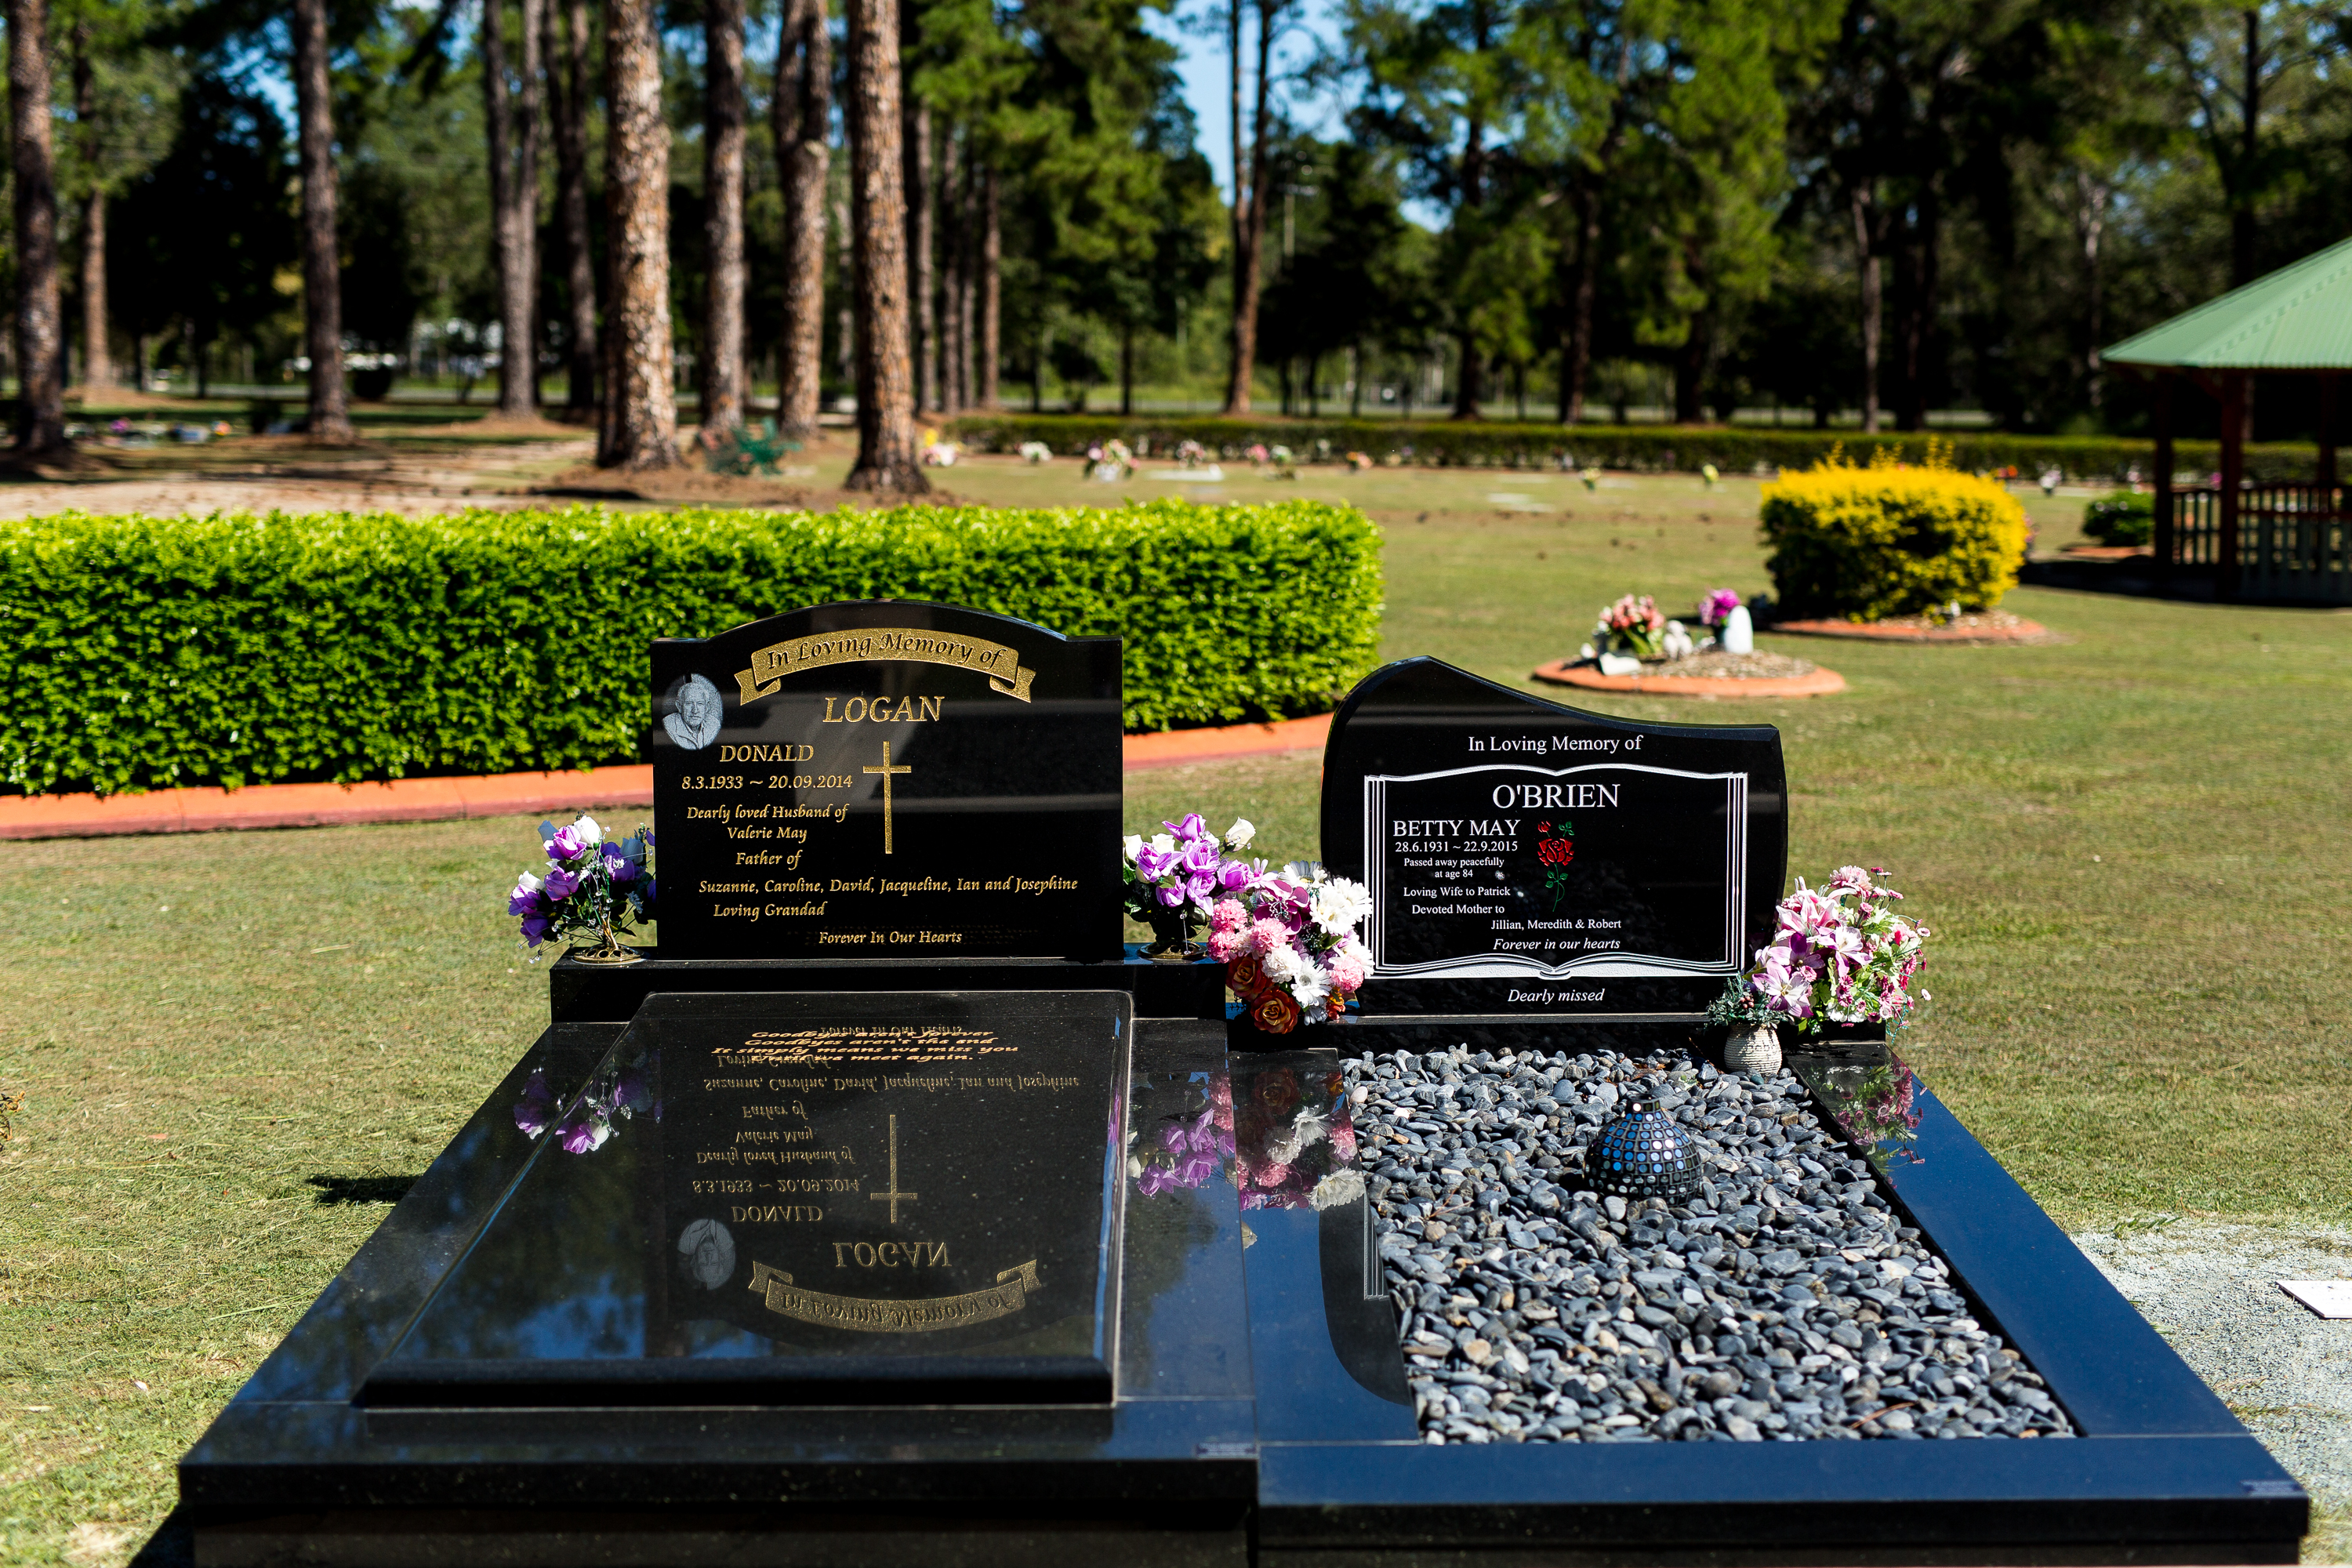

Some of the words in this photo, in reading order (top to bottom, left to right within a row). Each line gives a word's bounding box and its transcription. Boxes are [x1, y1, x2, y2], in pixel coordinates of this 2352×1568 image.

[768, 651, 791, 670] In
[798, 636, 871, 660] Loving
[879, 632, 972, 661] Memory
[979, 648, 1003, 669] of
[822, 695, 946, 723] LOGAN
[719, 744, 815, 762] DONALD
[1468, 736, 1485, 751] In
[1490, 735, 1547, 755] Loving
[1552, 735, 1621, 754] Memory
[1624, 734, 1644, 750] of
[681, 775, 743, 789] 8.3.1933
[768, 775, 853, 789] 20.09.2014
[1492, 783, 1621, 809] O'BRIEN
[687, 804, 731, 824] Dearly
[735, 804, 771, 818] loved
[771, 803, 833, 818] Husband
[833, 803, 851, 823] of
[727, 825, 773, 839] Valerie
[776, 826, 808, 844] May
[1392, 819, 1465, 837] BETTY
[1469, 819, 1521, 836] MAY
[1395, 841, 1449, 852] 28.6.1931
[1463, 840, 1518, 852] 22.9.2015
[735, 849, 783, 865] Father
[786, 849, 804, 871] of
[1403, 857, 1433, 866] Passed
[1435, 859, 1457, 869] away
[1460, 856, 1504, 869] peacefully
[1445, 871, 1461, 880] age
[1462, 869, 1474, 878] 84
[699, 880, 759, 895] Suzanne,
[764, 877, 824, 894] Caroline,
[829, 877, 874, 893] David,
[879, 876, 951, 897] Jacqueline,
[956, 878, 980, 891] Ian
[985, 875, 1012, 891] and
[1014, 875, 1078, 896] Josephine
[1403, 887, 1438, 899] Loving
[1439, 886, 1464, 896] Wife
[1465, 887, 1475, 896] to
[1477, 886, 1511, 896] Patrick
[713, 903, 760, 922] Loving
[764, 901, 828, 916] Grandad
[1411, 904, 1454, 914] Devoted
[1456, 903, 1493, 914] Mother
[1494, 905, 1505, 913] to
[1490, 919, 1525, 931] Jillian,
[1527, 919, 1573, 929] Meredith
[1574, 919, 1585, 929] &
[1588, 918, 1622, 929] Robert
[818, 931, 867, 944] Forever
[869, 931, 884, 943] In
[889, 931, 916, 943] Our
[918, 931, 963, 943] Hearts
[1493, 938, 1541, 950] Forever
[1544, 938, 1556, 949] in
[1559, 941, 1581, 949] our
[1583, 937, 1621, 949] hearts
[1507, 989, 1555, 1005] Dearly
[1558, 988, 1606, 1002] missed
[745, 1039, 843, 1047] Goodbyes
[752, 1031, 848, 1040] Goodbyes
